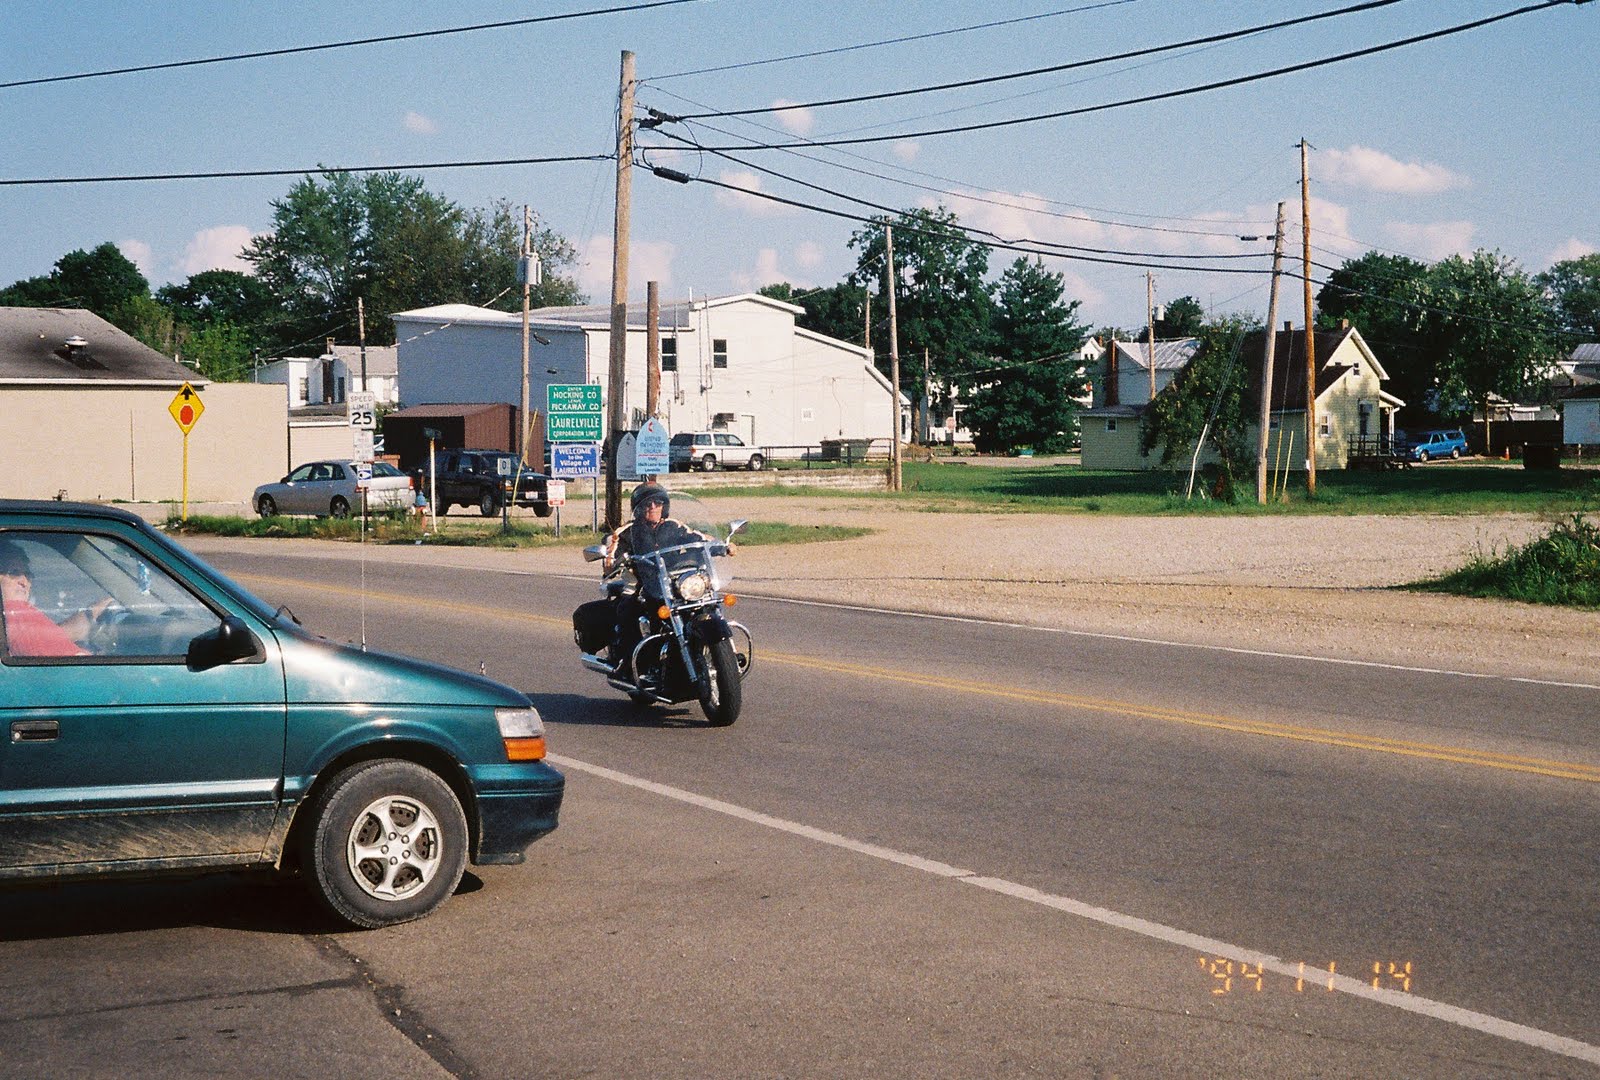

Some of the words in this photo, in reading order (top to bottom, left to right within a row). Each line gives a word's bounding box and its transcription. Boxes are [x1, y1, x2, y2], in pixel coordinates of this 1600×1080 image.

[553, 391, 584, 399] HOCKING
[586, 391, 597, 399] CO
[351, 411, 373, 425] 25
[550, 417, 600, 428] LAURELVILLE
[558, 447, 592, 455] WELCOME
